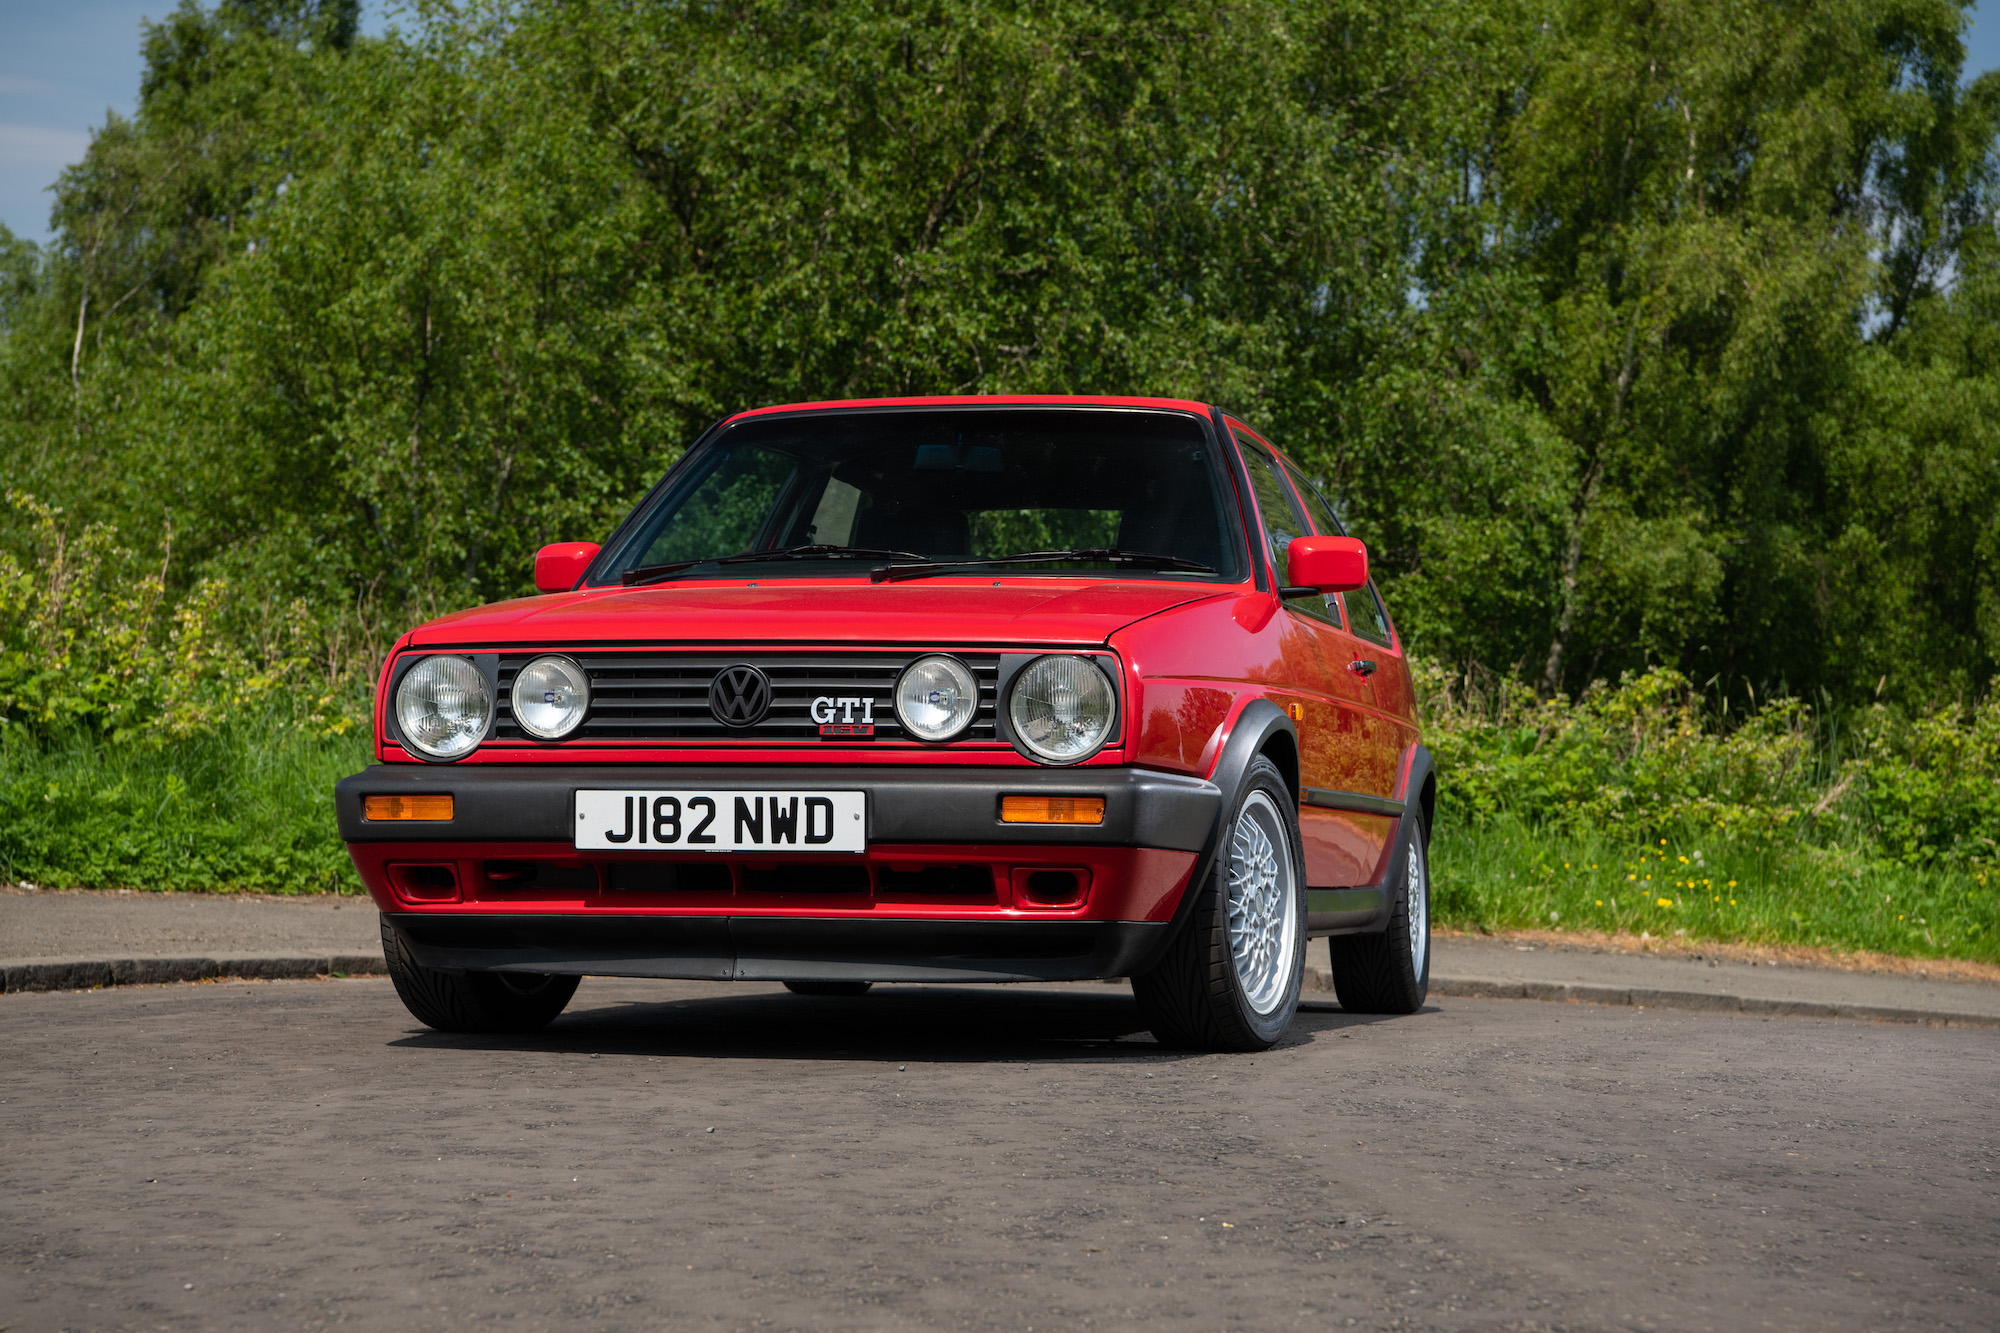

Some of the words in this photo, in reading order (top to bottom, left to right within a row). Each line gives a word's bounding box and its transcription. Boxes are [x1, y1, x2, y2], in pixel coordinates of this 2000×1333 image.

[810, 696, 875, 724] GTI
[604, 796, 716, 844] J182
[734, 796, 834, 844] NWD
